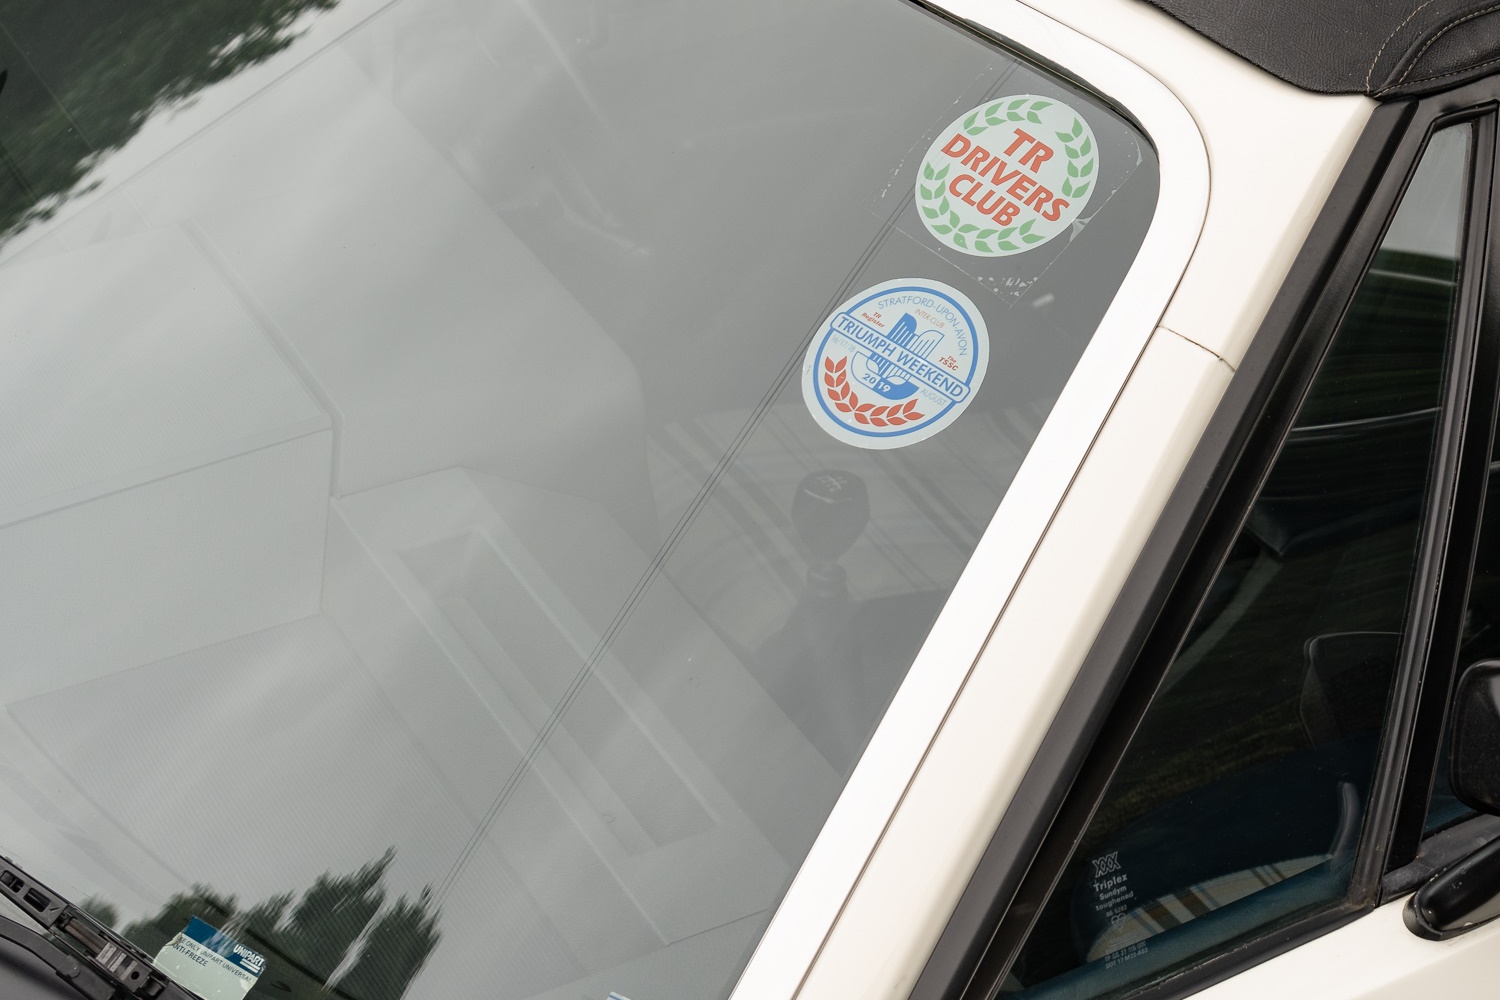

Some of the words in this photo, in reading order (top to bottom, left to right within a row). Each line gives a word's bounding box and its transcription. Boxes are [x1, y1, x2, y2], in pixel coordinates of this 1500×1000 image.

[1003, 128, 1054, 174] TR
[940, 133, 1070, 222] DRIVERS
[948, 173, 1021, 227] CLUB
[861, 312, 886, 328] Register
[874, 311, 882, 319] TR
[878, 295, 968, 356] STRATFORD-UPON-AVON
[915, 308, 945, 329] INTER-CLUB
[837, 316, 897, 357] TRIUMPH
[897, 350, 964, 397] WEEKEND
[938, 356, 959, 371] TSSC
[920, 388, 948, 407] AUGUST
[1093, 873, 1128, 892] Triplex
[1099, 885, 1127, 901] Sundym
[1095, 890, 1134, 911] toughened
[172, 943, 209, 967] ANTI-FREEZE
[186, 938, 200, 952] ONLY
[200, 948, 223, 965] UNIPART
[233, 943, 265, 967] UNIPART
